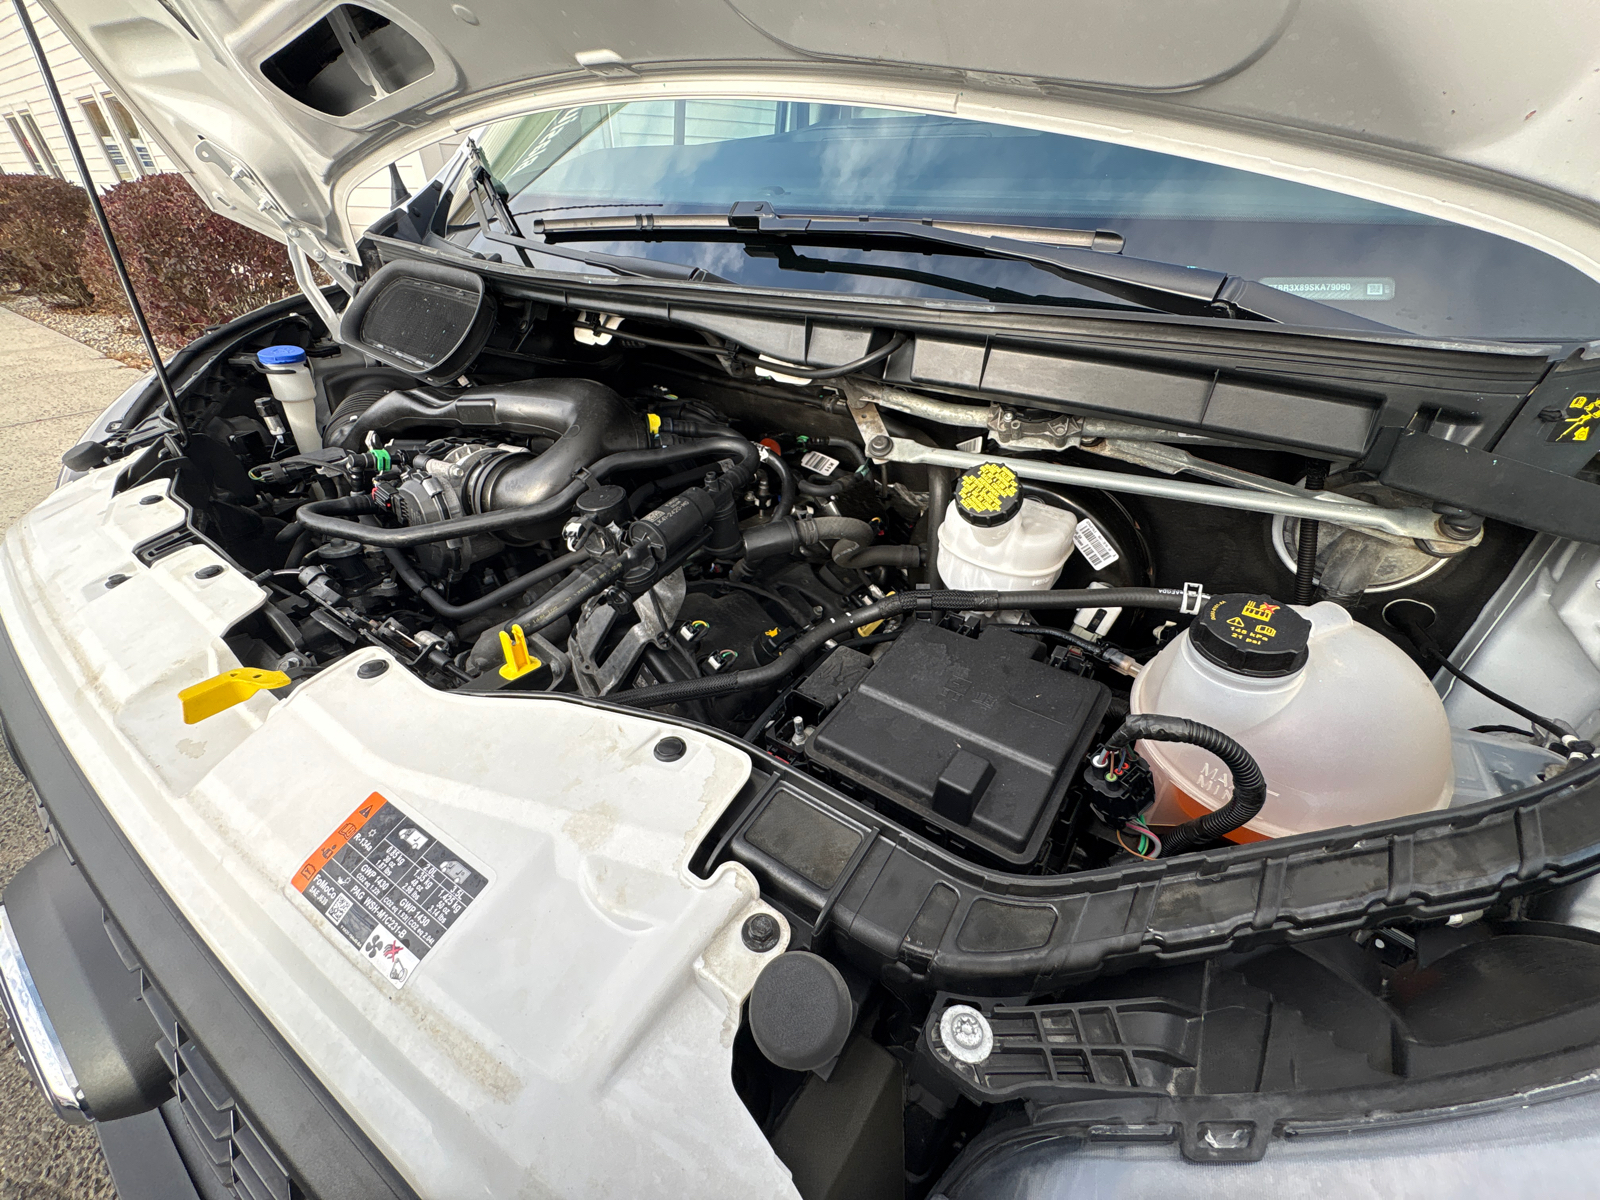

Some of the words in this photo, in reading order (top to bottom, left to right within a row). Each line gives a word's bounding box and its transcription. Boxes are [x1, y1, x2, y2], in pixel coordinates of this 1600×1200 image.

[1231, 632, 1243, 640] 21
[1245, 637, 1261, 645] psi
[1249, 631, 1269, 641] kPa
[353, 832, 374, 852] R-134a
[383, 856, 391, 864] 30
[388, 860, 396, 869] oz
[385, 845, 400, 860] 0.85
[394, 854, 407, 867] kg
[375, 859, 386, 870] 1.87
[383, 867, 393, 876] lbs
[423, 863, 438, 878] 2.0L
[356, 872, 367, 883] CO2
[363, 880, 372, 888] eq
[360, 863, 377, 879] GWP
[373, 875, 390, 891] 1430
[410, 878, 419, 887] 48
[416, 884, 424, 892] oz
[412, 868, 428, 883] 1.35
[422, 877, 435, 890] kg
[308, 886, 320, 898] SAE
[312, 874, 339, 900] FoMoCo
[411, 890, 421, 901] lbs
[450, 885, 466, 900] 3.5L
[383, 896, 394, 907] CO2
[390, 905, 399, 913] eq
[436, 900, 445, 910] 50
[442, 906, 450, 915] oz
[437, 889, 455, 906] 1.425
[450, 901, 463, 914] kg
[350, 885, 366, 900] PAG
[362, 896, 408, 939] WSH-M1C231-B
[398, 897, 417, 915] GWP
[413, 910, 431, 927] 1430
[427, 904, 440, 917] 3.14
[437, 913, 448, 924] lbs
[408, 919, 419, 930] CO2
[416, 928, 424, 936] eq
